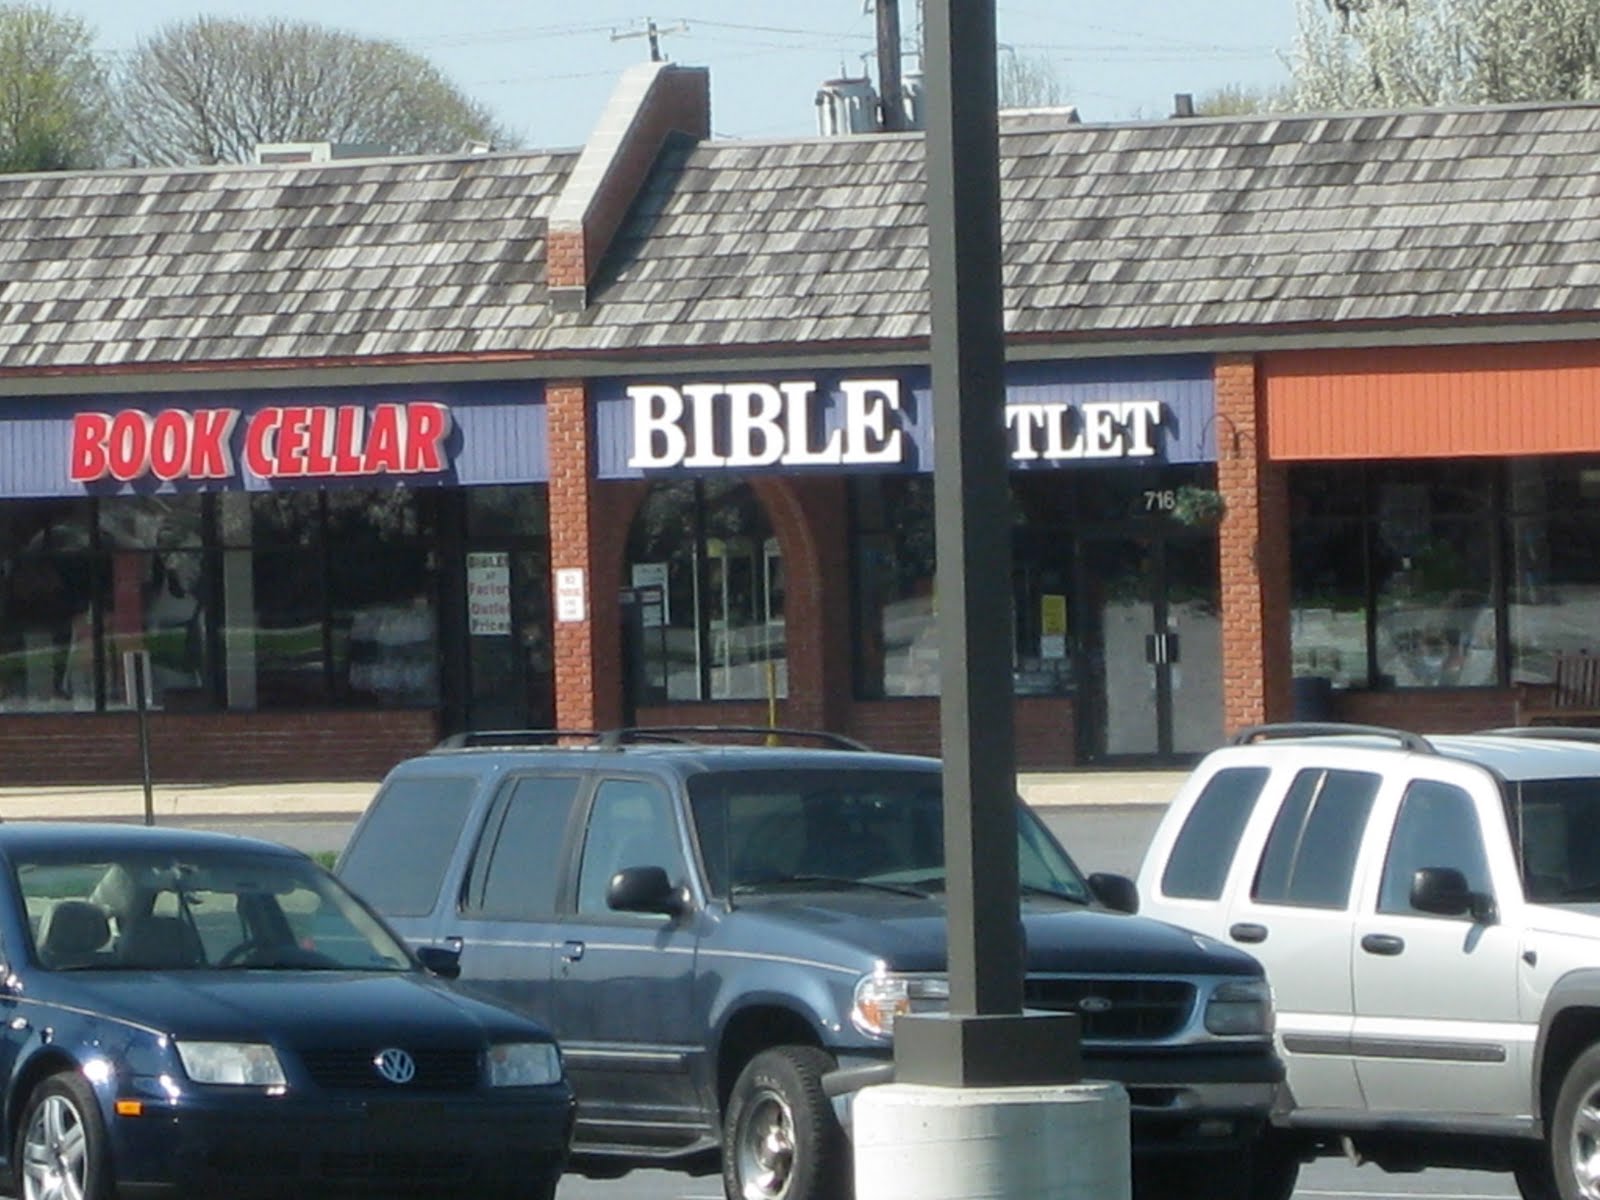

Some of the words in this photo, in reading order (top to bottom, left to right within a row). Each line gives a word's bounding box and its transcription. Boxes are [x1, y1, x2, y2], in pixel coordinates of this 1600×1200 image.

[70, 408, 241, 481] BOOK
[244, 402, 452, 478] CELLAR
[626, 379, 902, 468] BIBLE
[1005, 400, 1161, 460] TLET
[1143, 490, 1176, 511] 716
